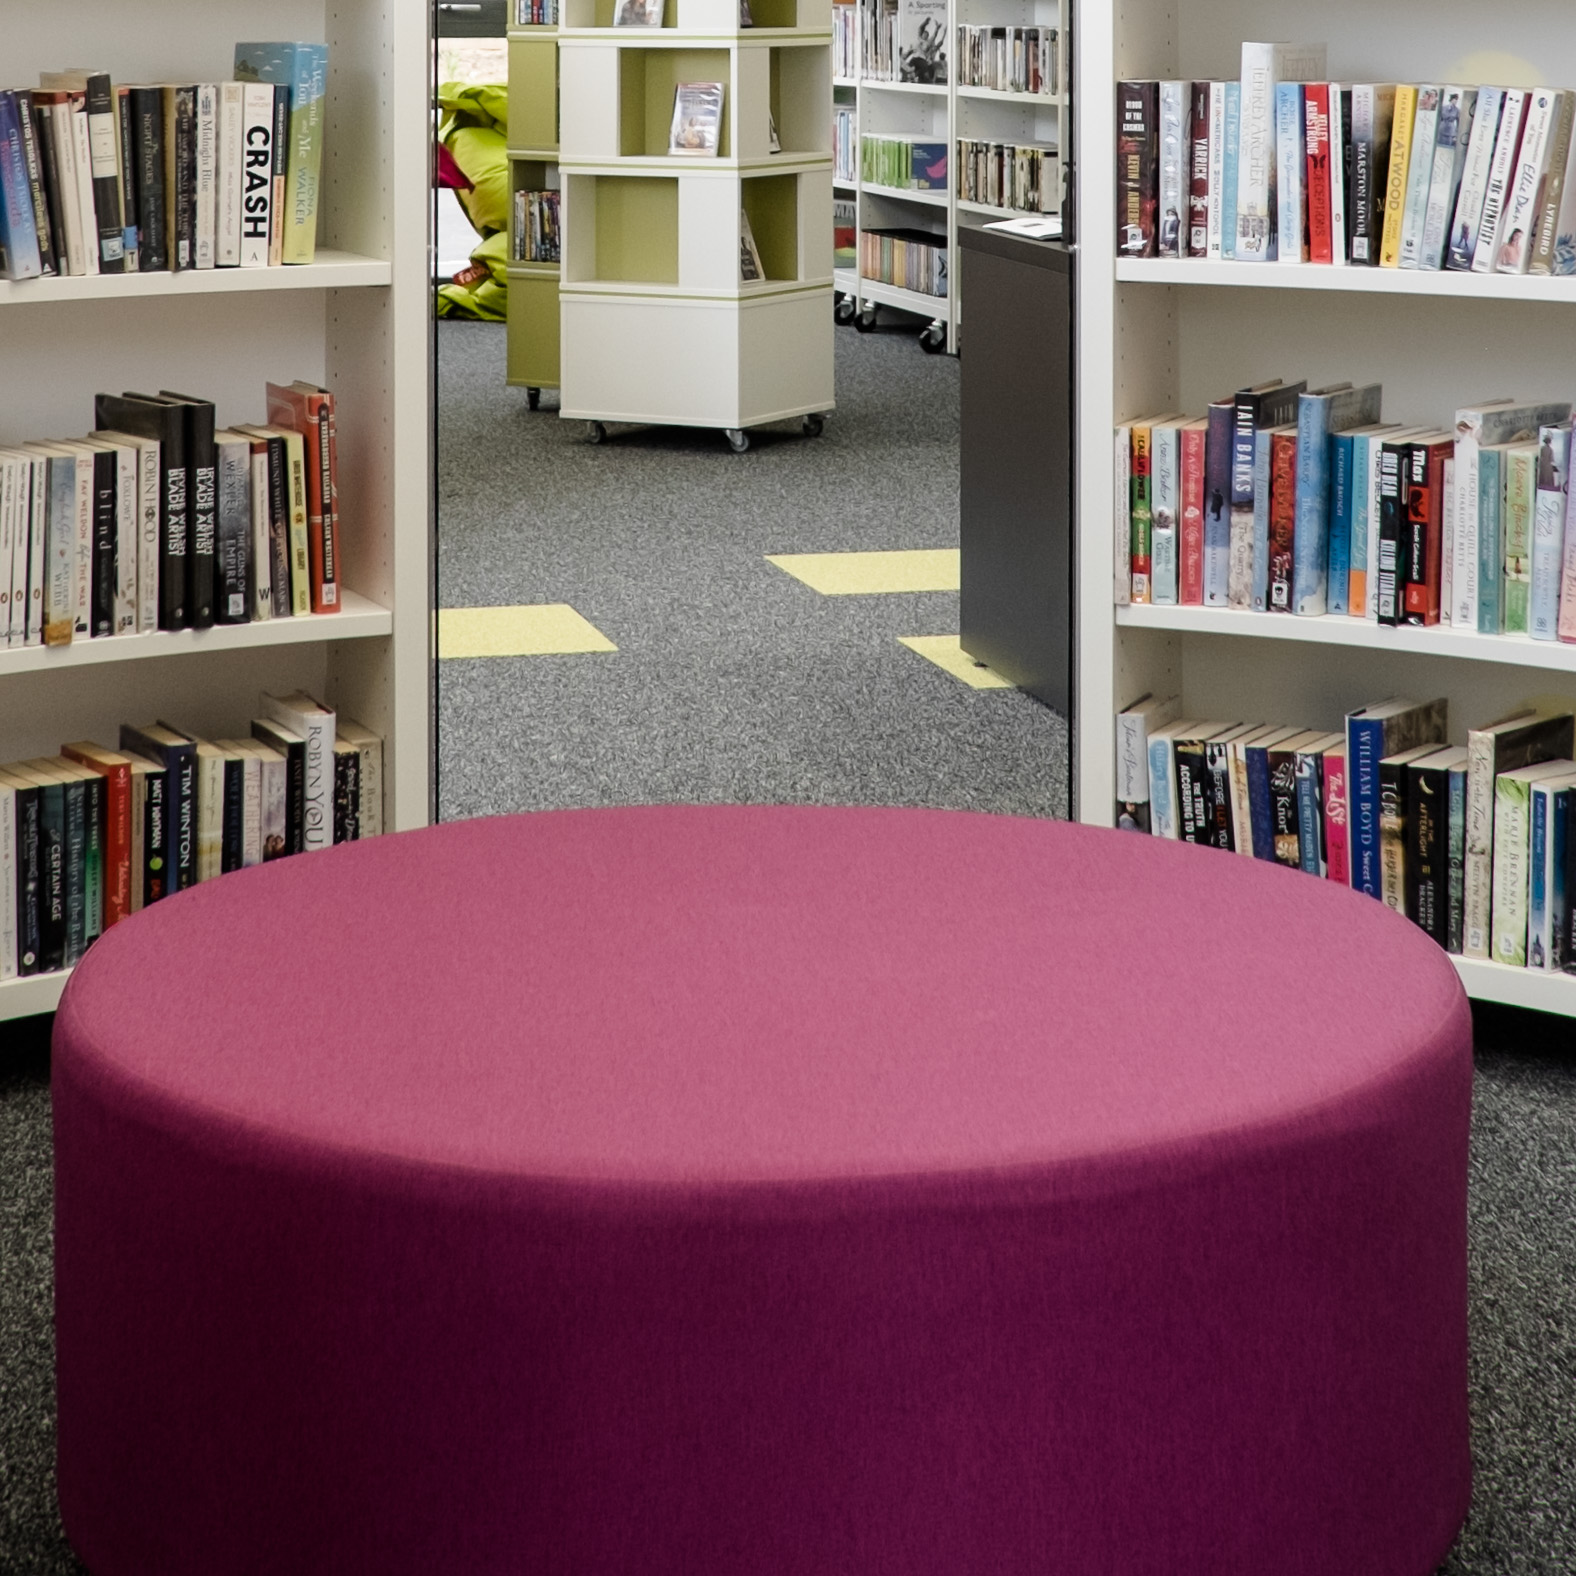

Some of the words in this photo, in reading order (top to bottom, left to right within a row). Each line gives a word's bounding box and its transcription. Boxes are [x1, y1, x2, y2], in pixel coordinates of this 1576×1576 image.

[1250, 67, 1270, 121] JEFFREY
[1280, 91, 1290, 134] ARCHER
[19, 98, 32, 138] CHRISTOS
[26, 140, 39, 179] TSIOLKAS
[143, 113, 153, 143] NIGHT
[200, 119, 213, 166] Midnight
[1306, 100, 1319, 155] ARMSTRONG
[1317, 114, 1328, 141] KELLEY
[144, 148, 155, 184] STAGES
[1127, 154, 1140, 179] KEVIN
[1194, 137, 1208, 179] YARRICK
[1249, 121, 1268, 188] ARCHER
[1355, 142, 1367, 197] MARSTON
[1388, 140, 1405, 211] ATWOOD
[201, 169, 212, 192] Blue
[244, 126, 270, 238] CRASH
[295, 167, 307, 225] WALKER
[307, 176, 316, 217] FIONA
[1491, 178, 1503, 195] THE
[1519, 163, 1535, 192] Ellie
[32, 181, 46, 227] merciless
[1312, 170, 1326, 237] DECEPTIONS
[1355, 199, 1367, 235] MOOR
[1479, 197, 1497, 245] HYPNOTIST
[1511, 194, 1530, 223] Dean
[38, 229, 50, 252] gods
[1539, 203, 1556, 256] LYREBIRD
[1235, 404, 1254, 437] IAIN
[144, 450, 157, 494] ROBIN
[270, 442, 281, 485] EDMUND
[1235, 443, 1253, 493] BANKS
[1301, 454, 1312, 486] BARRY
[1412, 449, 1426, 482] Max
[168, 468, 180, 510] BLADE
[196, 468, 208, 510] BLADE
[225, 459, 236, 515] WEXLER
[1467, 473, 1476, 509] HOUSE
[79, 499, 88, 539] WELDON
[98, 489, 112, 550] blind
[168, 513, 180, 555] ARTIST
[196, 513, 208, 555] ARTIST
[235, 530, 245, 548] THE
[1466, 523, 1476, 556] QUILL
[1511, 503, 1527, 549] Binchy
[225, 539, 236, 584] EMPIRE
[235, 549, 245, 577] GUNS
[1210, 546, 1218, 585] BAKEWELL
[1235, 544, 1246, 577] Quarry
[1457, 540, 1465, 567] BETTS
[78, 585, 87, 607] WAR
[1466, 561, 1475, 599] COURT
[307, 725, 323, 788] ROBYN
[1359, 729, 1372, 794] WILLIAM
[151, 778, 163, 804] MATT
[180, 765, 192, 795] TIM
[1179, 764, 1194, 819] ACCORDING
[1213, 769, 1225, 805] BEFORE
[151, 806, 162, 849] WHYMAN
[244, 770, 261, 857] WEATHERING
[1185, 821, 1194, 833] TO
[1195, 798, 1205, 827] TRUTH
[1359, 802, 1372, 844] BOYD
[1419, 802, 1428, 857] AFTERLIGHT
[1510, 805, 1519, 846] MARIE
[179, 801, 191, 868] WINTON
[50, 843, 61, 894] CERTAIN
[69, 837, 81, 882] History
[1362, 850, 1371, 879] Sweet
[1509, 852, 1520, 916] BRENNAN
[50, 897, 61, 921] AGE
[70, 902, 81, 920] the
[70, 923, 81, 952] Rain
